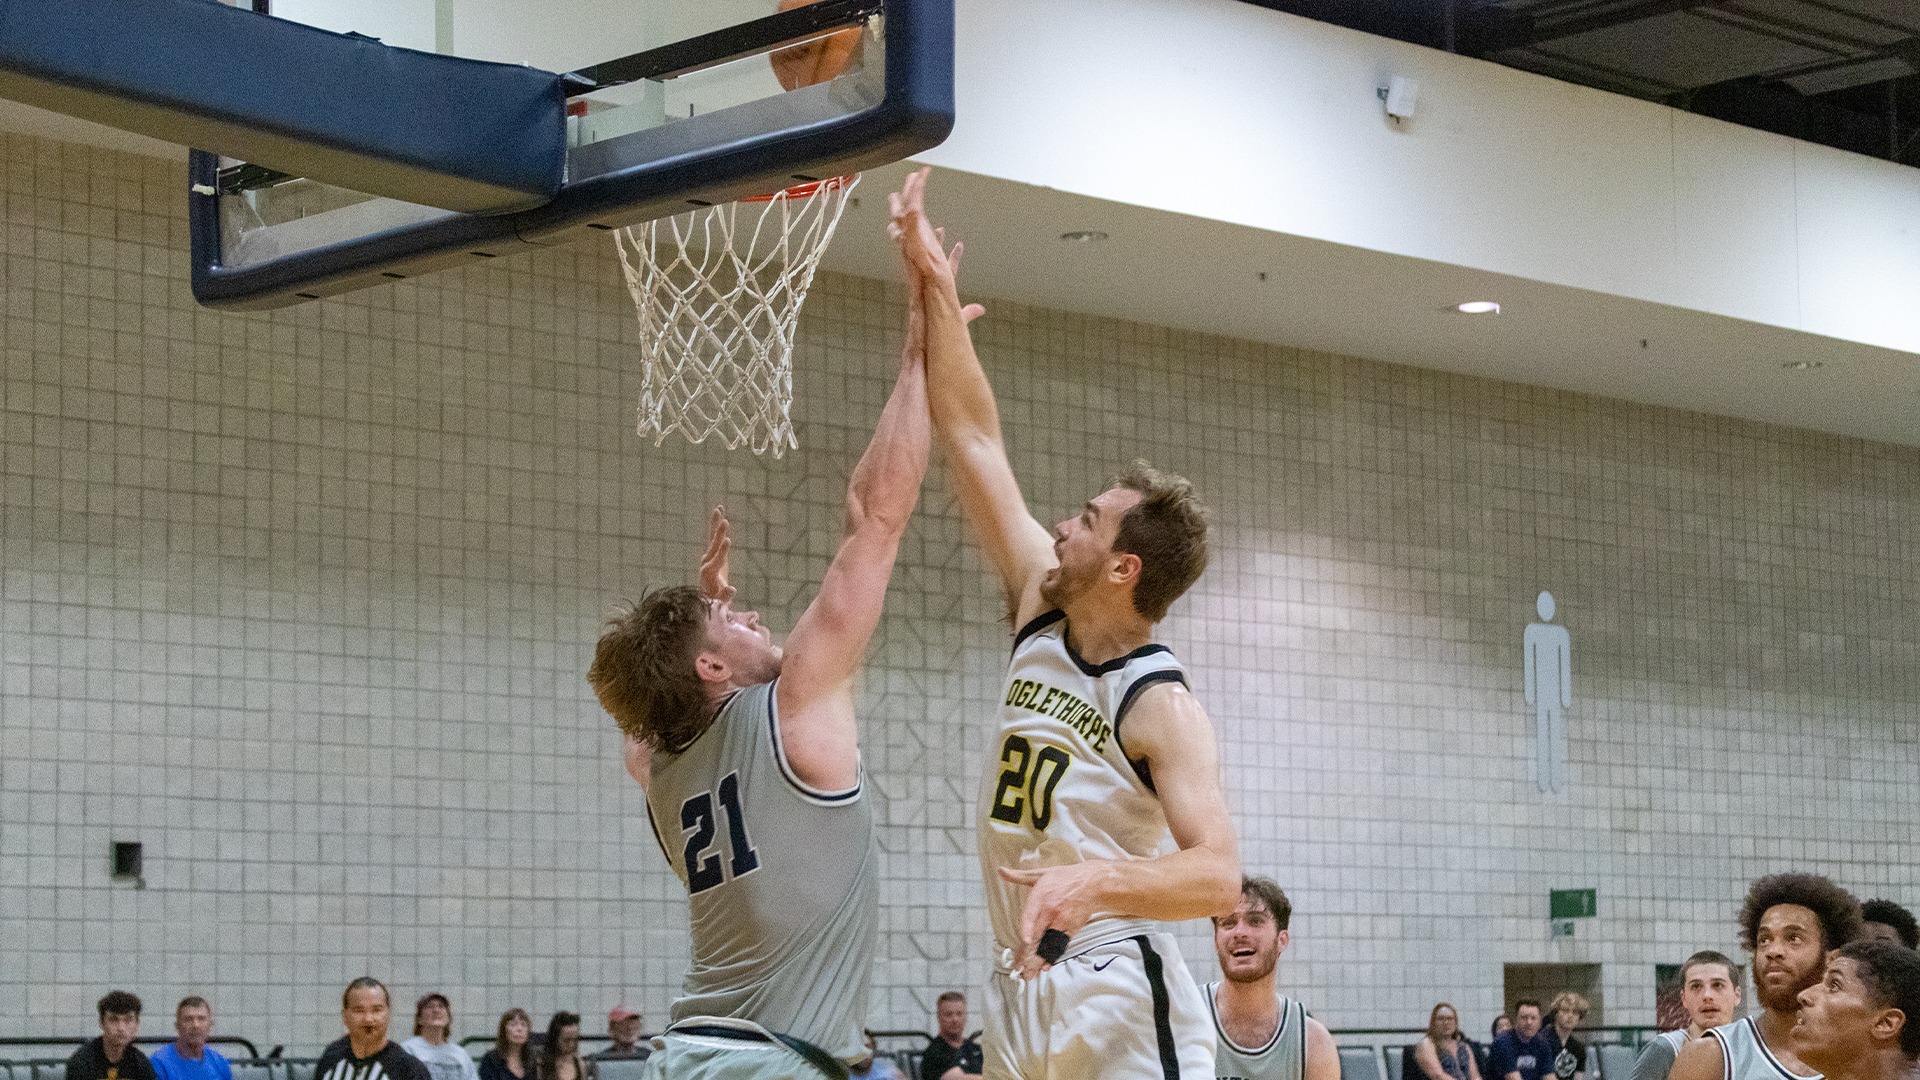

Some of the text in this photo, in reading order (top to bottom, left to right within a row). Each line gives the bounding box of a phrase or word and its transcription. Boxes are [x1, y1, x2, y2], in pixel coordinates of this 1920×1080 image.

[1005, 678, 1112, 754] OGLETHORPE
[990, 733, 1072, 832] 20
[680, 769, 762, 897] 21
